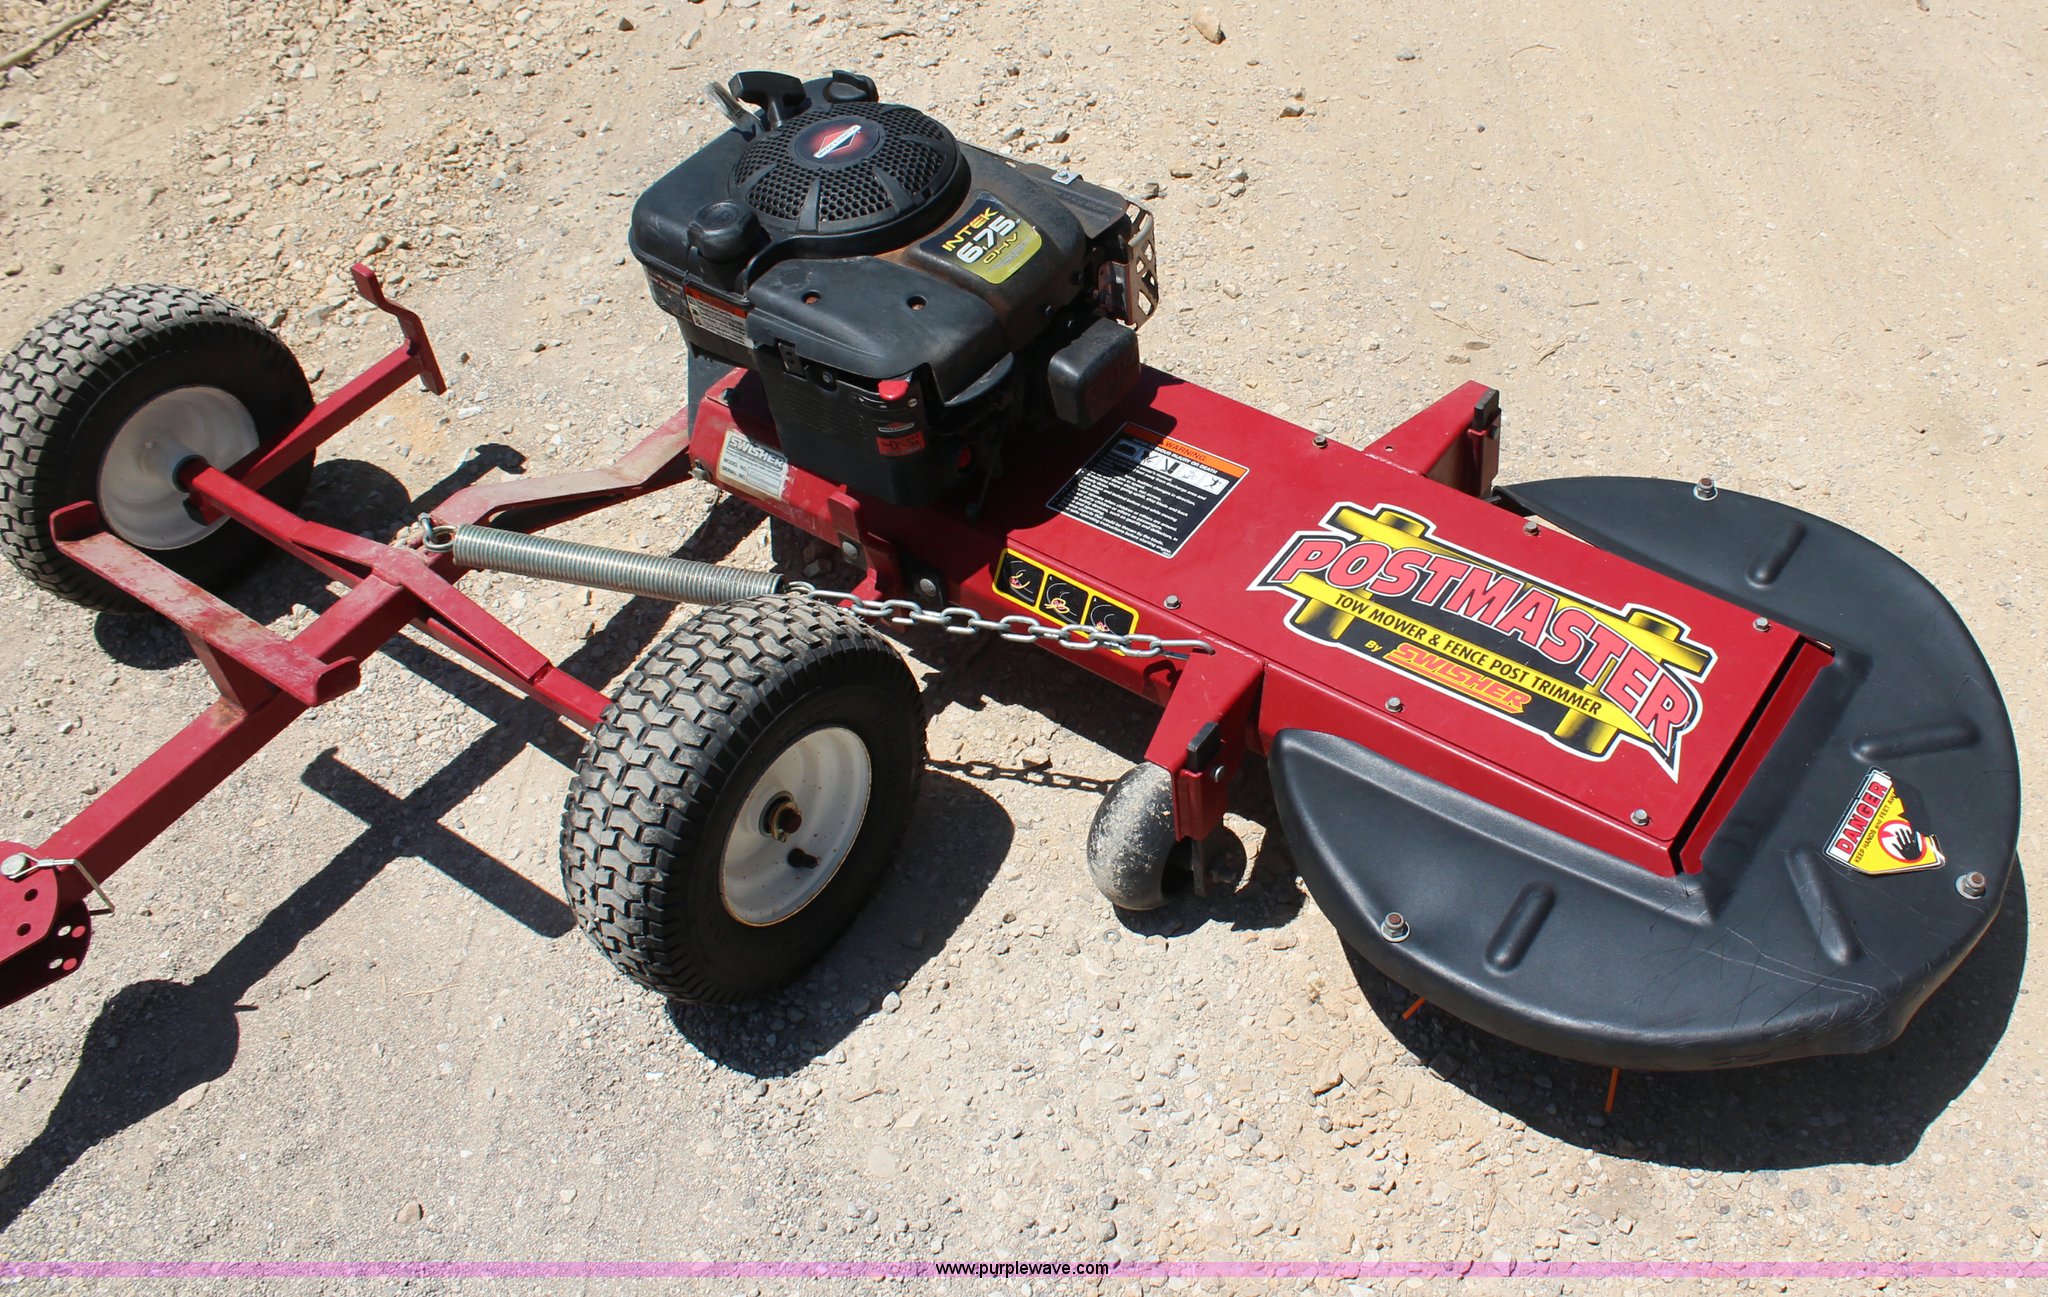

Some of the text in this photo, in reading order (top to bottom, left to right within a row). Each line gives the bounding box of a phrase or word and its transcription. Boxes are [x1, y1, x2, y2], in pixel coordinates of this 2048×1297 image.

[942, 207, 998, 252] INTEK
[956, 215, 1016, 264] 6.75
[983, 232, 1018, 264] OHV
[728, 437, 785, 469] SWISHER
[1163, 441, 1207, 461] WARNING
[1170, 452, 1191, 463] INJURY
[1198, 464, 1218, 474] DEATH
[1271, 538, 1692, 750] POSTMASTER
[1334, 593, 1602, 715] TOW MOWER & FENCE POST TRIMMER
[1364, 639, 1532, 708] By SWISHER
[1835, 781, 1888, 855] DANGER
[1854, 848, 1865, 863] KEEP
[1862, 828, 1876, 849] HANDS
[1879, 804, 1890, 818] FEET
